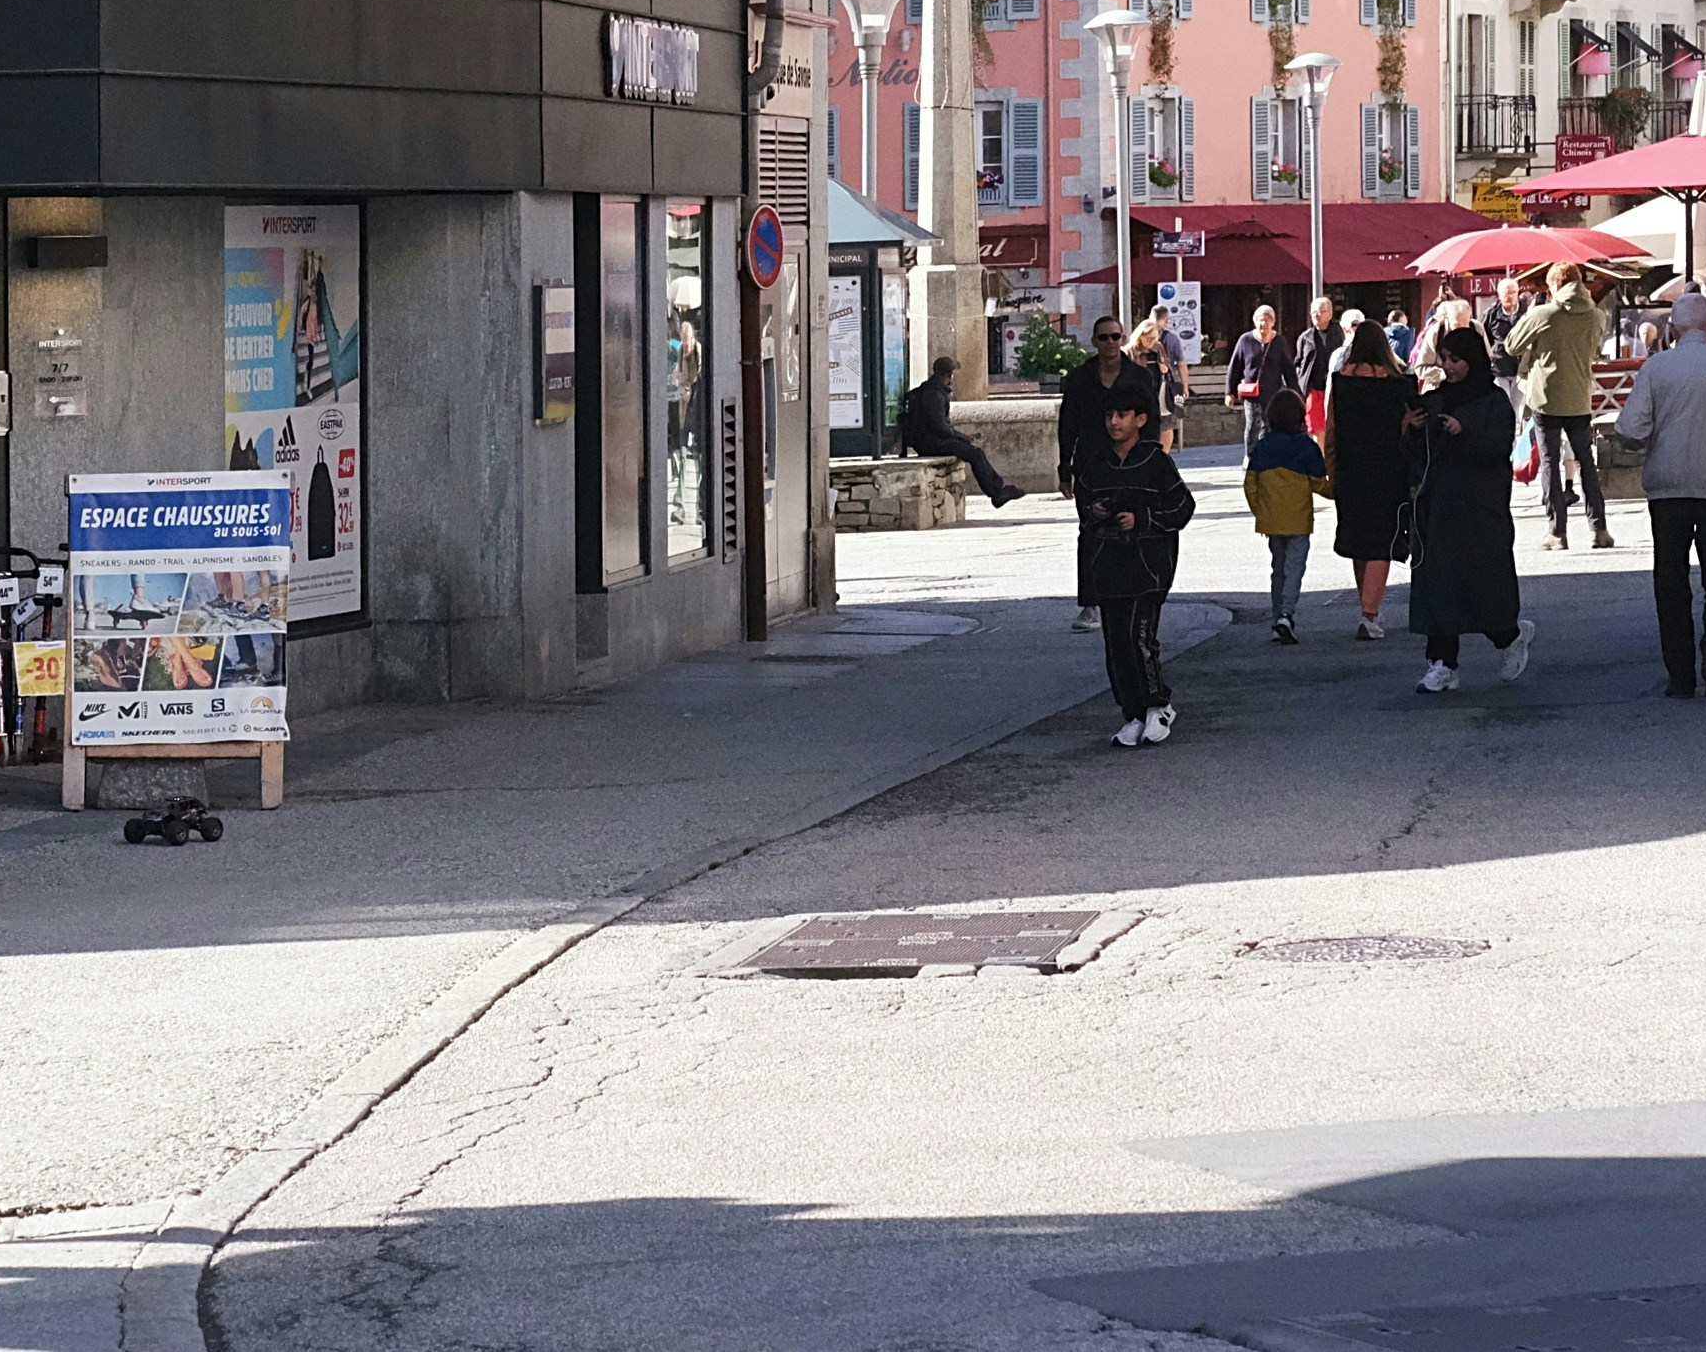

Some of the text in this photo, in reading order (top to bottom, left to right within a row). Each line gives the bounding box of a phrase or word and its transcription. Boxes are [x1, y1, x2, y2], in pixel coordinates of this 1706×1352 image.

[1562, 140, 1606, 149] Restaurant
[1561, 149, 1593, 157] Chinois
[269, 216, 317, 235] INTERSPORT
[1469, 278, 1482, 293] LE
[38, 339, 83, 348] INTERSPORT
[319, 418, 344, 431] EASTPAK
[275, 447, 300, 464] adidas
[155, 477, 212, 486] INTERSPORT
[80, 503, 271, 529] ESPACE CHAUSSURES
[213, 524, 282, 538] au sous-sol
[80, 555, 283, 567] SNEAKERS RANDO TRAIL ALPINISME SANDALES
[84, 703, 107, 713] NIKE
[159, 702, 194, 716] VANS
[121, 729, 176, 737] SKECHERS
